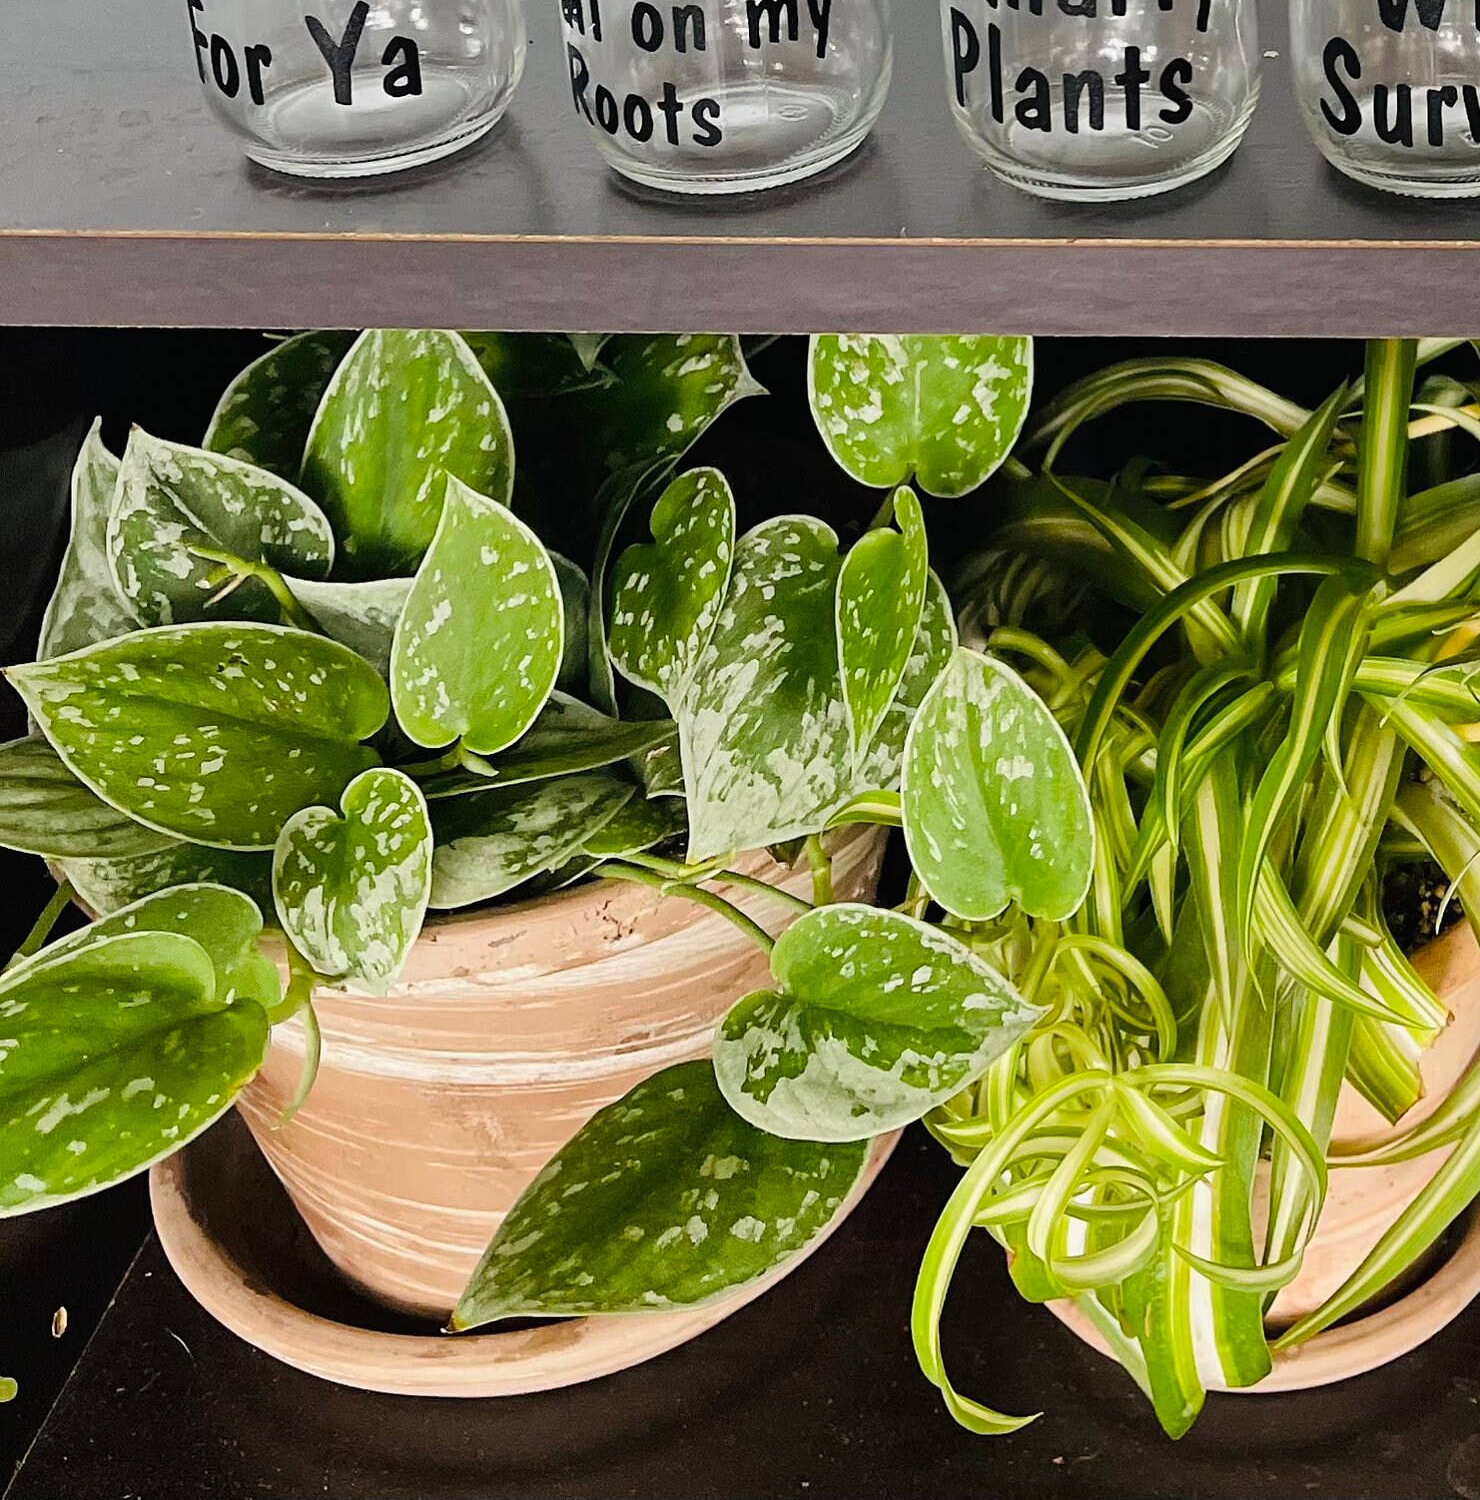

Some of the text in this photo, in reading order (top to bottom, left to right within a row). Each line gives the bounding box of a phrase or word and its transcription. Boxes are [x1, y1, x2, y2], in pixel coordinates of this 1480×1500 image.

[305, 0, 423, 106] Ya
[631, 2, 706, 53] on
[951, 6, 1194, 133] Plants
[567, 41, 723, 146] Roots
